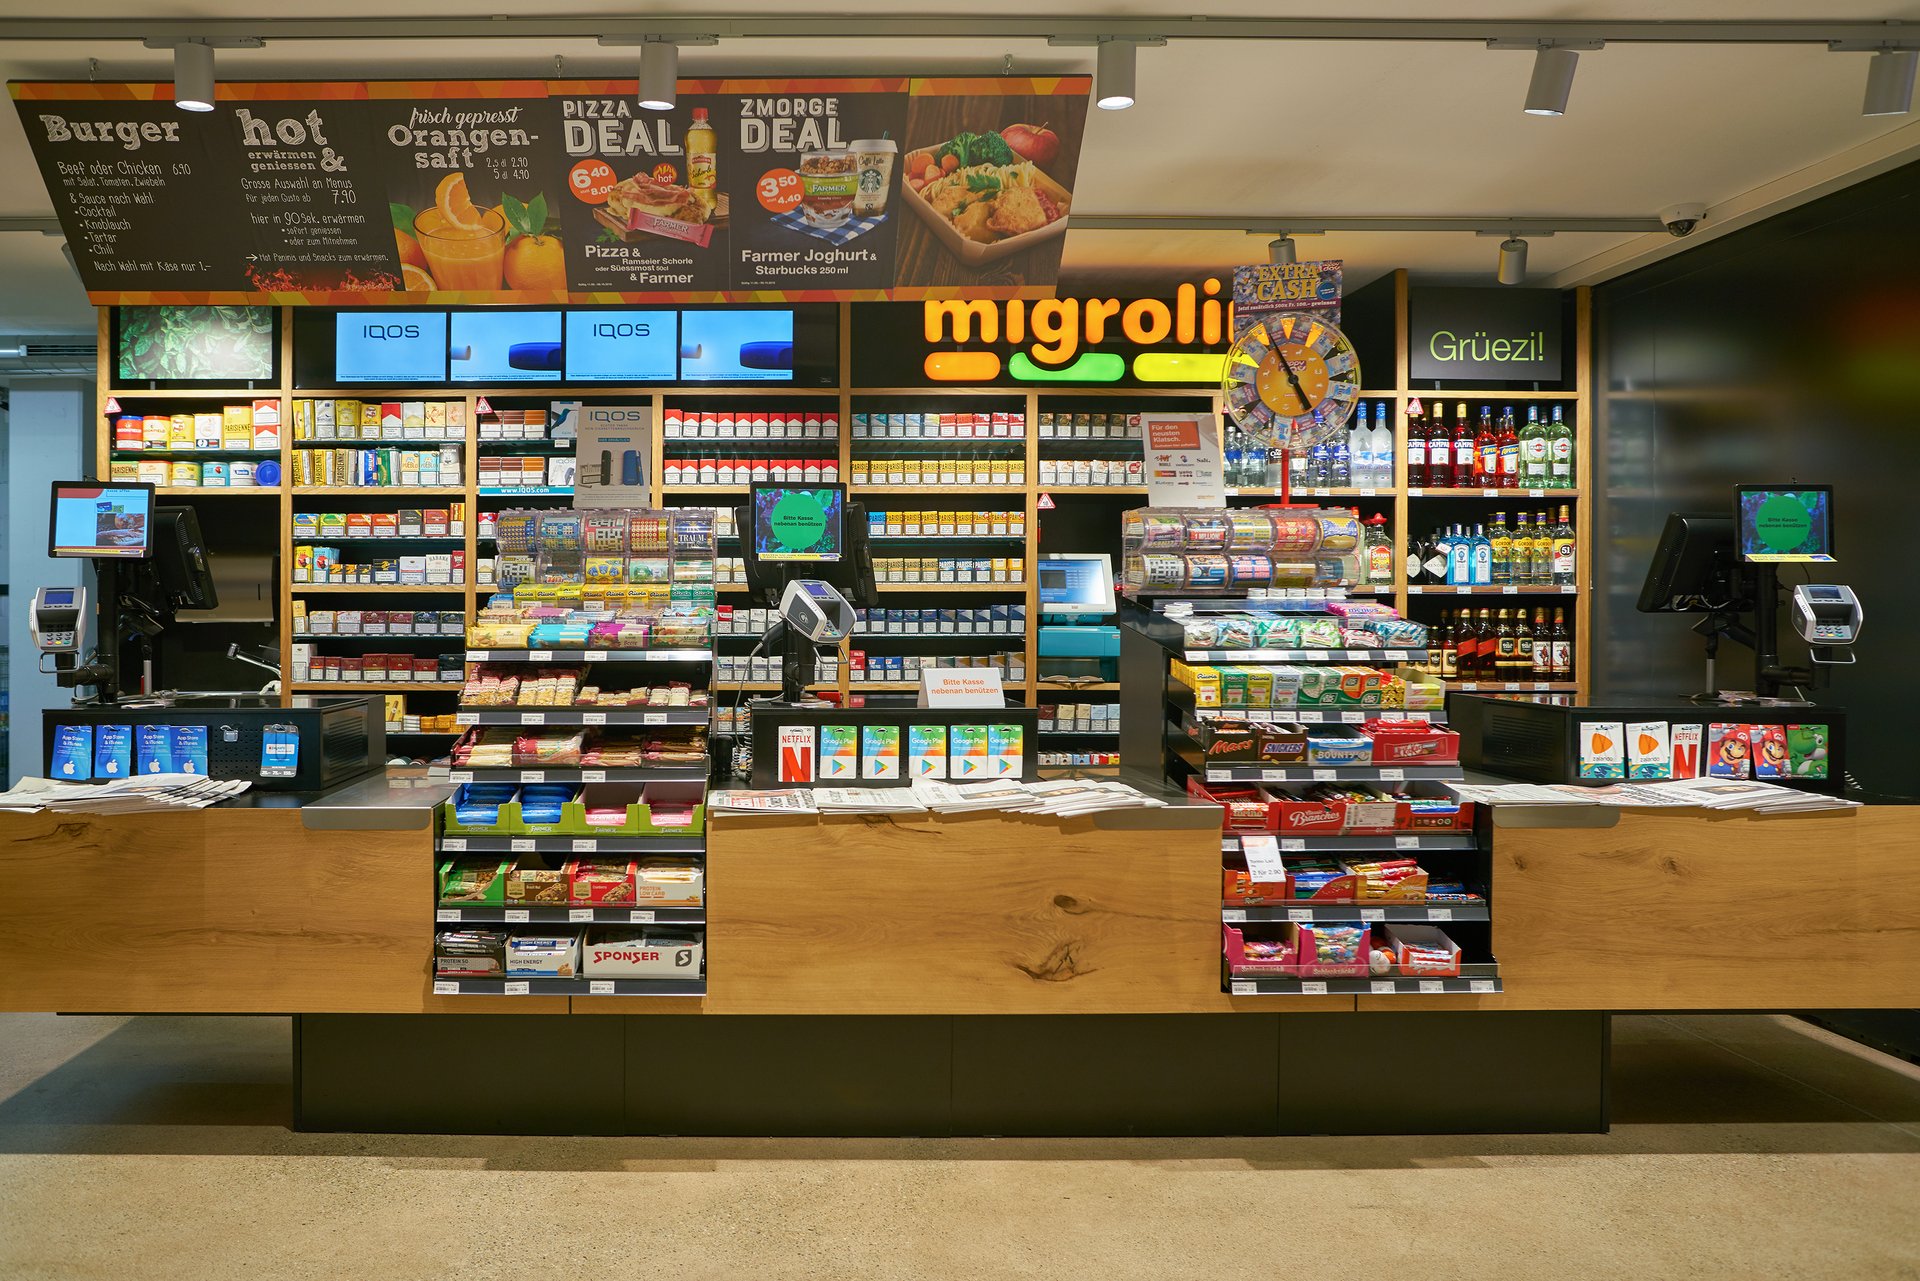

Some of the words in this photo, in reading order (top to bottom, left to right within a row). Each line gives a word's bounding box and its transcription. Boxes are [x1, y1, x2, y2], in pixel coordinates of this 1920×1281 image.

[562, 100, 632, 118] PIZZA
[740, 98, 839, 117] ZMORGE
[409, 107, 453, 129] frisch
[455, 106, 523, 129] gepresst
[39, 114, 180, 150] Burger
[236, 108, 328, 146] hot
[387, 124, 539, 153] Orangen-
[563, 119, 684, 157] DEAL
[740, 117, 848, 153] DEAL
[248, 151, 316, 159] erwärmen
[320, 147, 347, 172] &
[414, 146, 474, 169] saft
[57, 161, 85, 175] Beef
[90, 160, 113, 175] oder
[117, 160, 162, 175] Chicken
[172, 163, 191, 176] 6.90
[251, 161, 316, 173] geniessen
[511, 157, 528, 168] 2.90
[494, 169, 500, 180] 5
[513, 169, 529, 180] 4.90
[658, 174, 672, 183] hot
[63, 177, 75, 186] mit
[134, 177, 165, 187] Zwiebeln
[241, 178, 271, 190] Grosse
[275, 177, 309, 189] Auswahl
[312, 180, 323, 189] an
[326, 178, 352, 189] Menus
[812, 184, 847, 193] FARMER
[70, 193, 77, 203] &
[79, 193, 106, 204] Sauce
[109, 192, 131, 203] nach
[261, 193, 279, 204] jeden
[302, 194, 311, 203] ab
[331, 190, 356, 205] 7.90
[778, 193, 801, 205] 4.40
[79, 206, 116, 217] Cocktail
[85, 219, 131, 230] Knoblauch
[251, 213, 269, 224] hier
[273, 214, 281, 224] in
[284, 212, 300, 225] 90
[300, 213, 320, 224] Sek.
[322, 213, 365, 224] erwärmen
[88, 232, 116, 242] Tartar
[286, 227, 307, 235] sofort
[310, 228, 342, 236] geniessen
[322, 237, 358, 245] Mitnehmen
[93, 245, 114, 254] Chili
[585, 245, 629, 258] Pizza
[632, 248, 641, 258] &
[273, 253, 297, 262] Paninis
[299, 253, 311, 262] und
[313, 253, 336, 262] Snacks
[338, 254, 352, 262] zum
[741, 250, 800, 262] Farmer
[804, 249, 868, 264] Joghurt
[870, 253, 877, 261] &
[94, 261, 116, 271] Nach
[118, 261, 138, 271] Wahl
[140, 261, 154, 271] mit
[158, 261, 178, 271] Käse
[181, 263, 196, 271] nur
[610, 264, 655, 272] Süessmost
[755, 265, 817, 275] Starbucks
[819, 266, 836, 274] 250
[837, 266, 849, 274] ml
[629, 273, 638, 281] &
[640, 273, 694, 284] Farmer
[1259, 265, 1319, 281] EXTRA
[1258, 279, 1318, 301] CASH
[924, 278, 1234, 364] migroli
[363, 325, 420, 340] IQOS
[593, 323, 650, 340] IQOS
[1429, 331, 1544, 362] Grüezi!
[589, 411, 640, 423] IQOS
[678, 534, 706, 542] TRAUM-
[782, 735, 811, 743] NETFLIX
[1208, 739, 1253, 755] Mars
[1264, 743, 1304, 752] SNICKERS
[1317, 751, 1354, 759] BOUNTY
[1289, 811, 1341, 827] Branches
[593, 952, 660, 964] SPONSER
